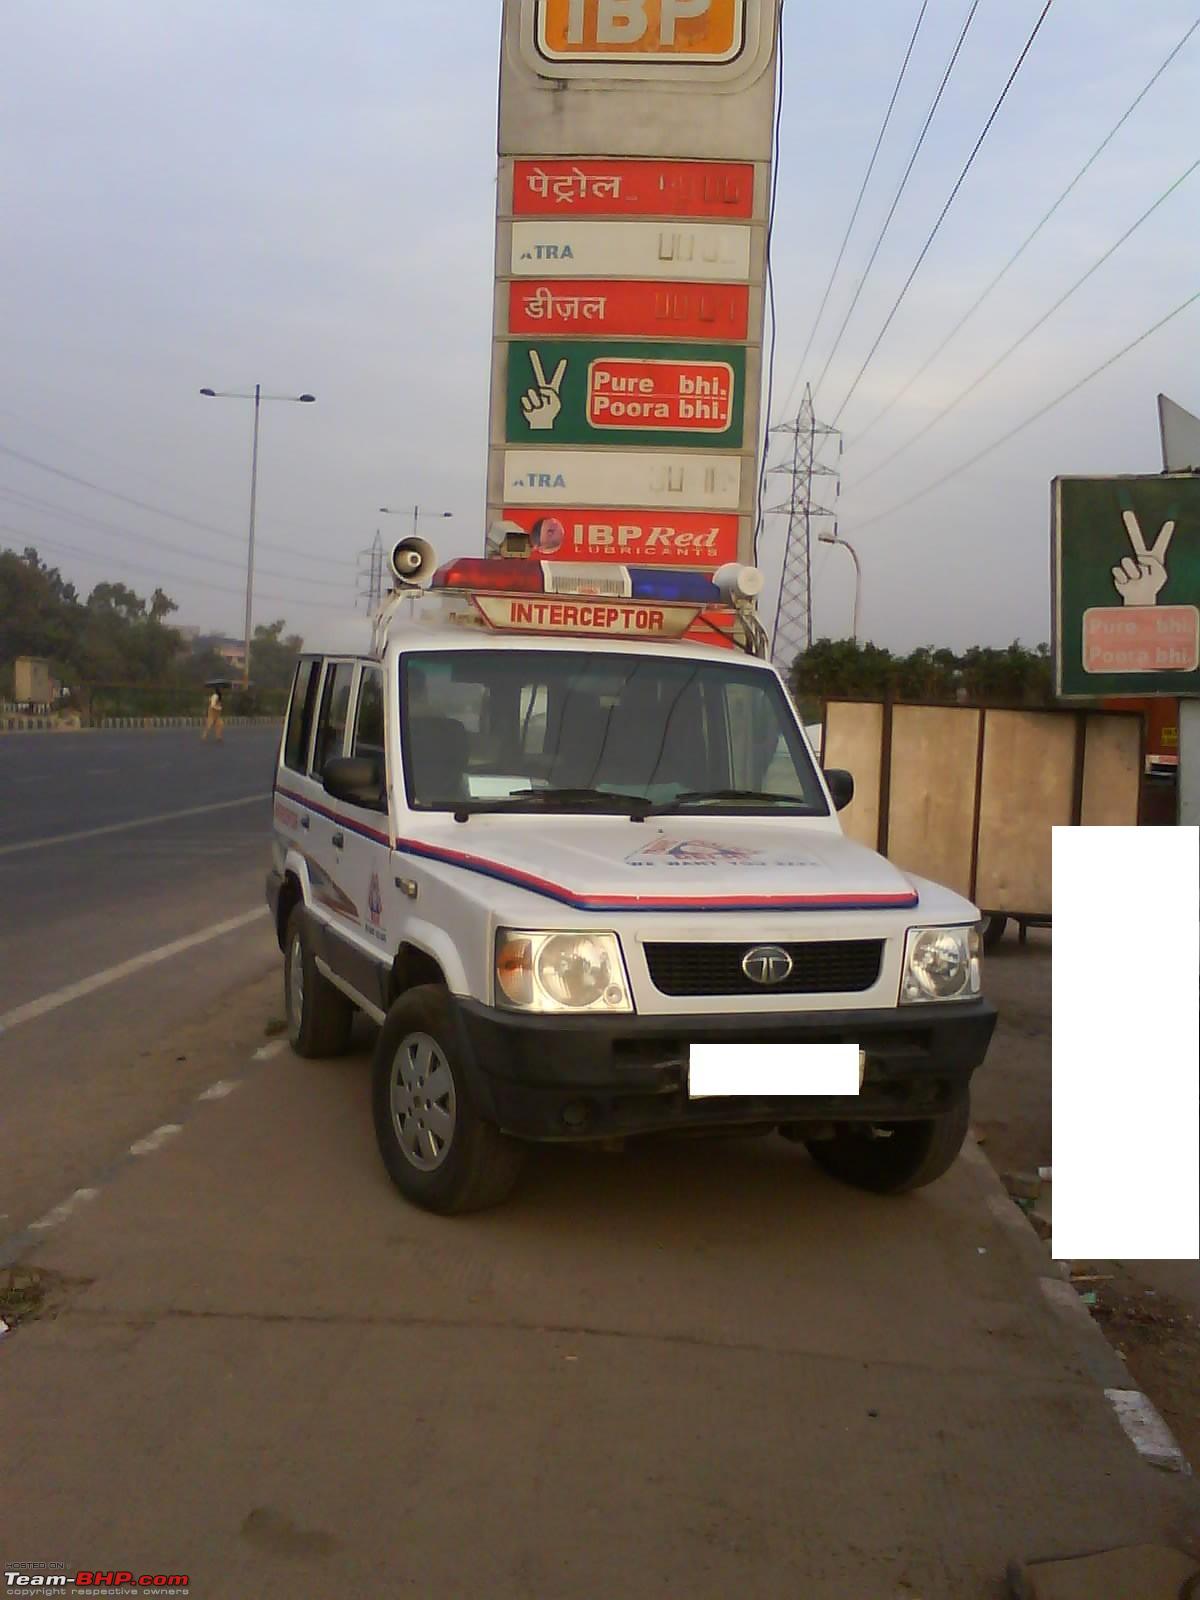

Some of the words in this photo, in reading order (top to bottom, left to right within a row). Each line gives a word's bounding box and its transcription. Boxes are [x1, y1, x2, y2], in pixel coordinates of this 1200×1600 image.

[566, 0, 711, 46] IBP
[526, 166, 622, 203] पेट्रोल
[522, 287, 607, 321] डीज़ल
[593, 371, 655, 393] Pure
[679, 374, 727, 396] bhi.
[593, 396, 670, 418] Poora
[678, 399, 727, 420] bhi.
[573, 524, 642, 545] IBP
[645, 526, 720, 548] Red
[574, 545, 718, 557] LUBRICANTS
[510, 602, 665, 630] INTERCEPTOR
